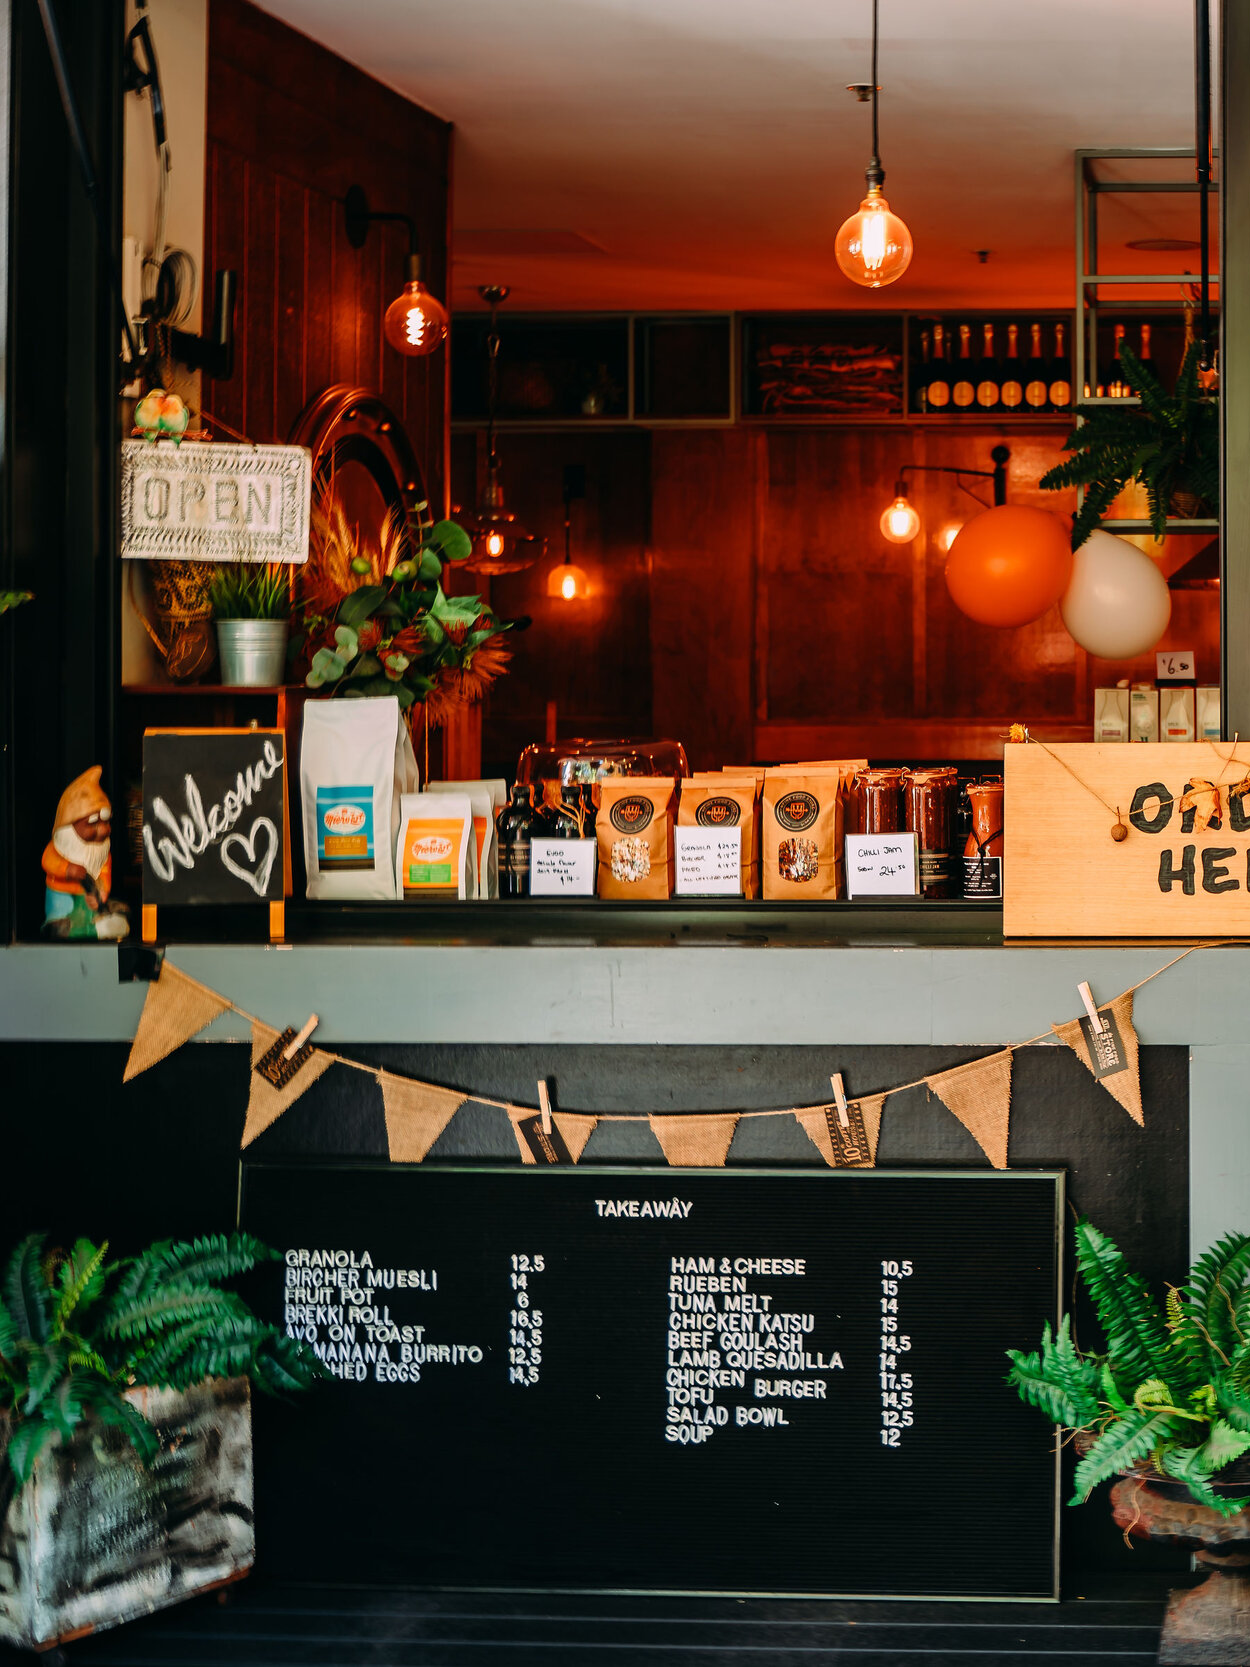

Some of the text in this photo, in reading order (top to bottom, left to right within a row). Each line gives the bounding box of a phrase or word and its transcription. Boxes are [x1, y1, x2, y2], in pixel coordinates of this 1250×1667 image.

[144, 478, 271, 525] OPEN
[143, 740, 284, 881] Welcome
[858, 849, 879, 857] CHILLI
[1101, 1032, 1116, 1067] STORE
[844, 1147, 862, 1162] 10
[595, 1199, 693, 1218] TAKEAWAY
[285, 1249, 373, 1268] GRANOLA
[671, 1257, 715, 1275] HAM
[719, 1257, 732, 1274] &
[734, 1258, 806, 1276] CHEESE
[285, 1268, 528, 1291] BIRCHER MUESLI 14
[669, 1275, 898, 1296] RUEBEN 15
[285, 1287, 529, 1308] FRUIT POT 6
[668, 1293, 899, 1314] TUNA MELT 14
[285, 1304, 344, 1325] BREKKI
[348, 1305, 394, 1326] ROLL
[669, 1312, 898, 1333] CHICKEN KATSU 15
[286, 1324, 318, 1343] AVO
[328, 1324, 356, 1344] ON
[365, 1325, 426, 1343] TOAST
[668, 1331, 713, 1350] BEEF
[720, 1332, 803, 1352] GOULASH
[313, 1342, 390, 1363] MANANA
[401, 1343, 483, 1365] BURRITO
[668, 1350, 897, 1371] LAMB QUESADILLA 14
[375, 1362, 420, 1382] EGGS
[666, 1369, 745, 1388] CHICKEN
[754, 1379, 827, 1399] BURGER
[666, 1387, 714, 1407] TOFU
[666, 1406, 729, 1426] SALAD
[736, 1406, 789, 1427] BOWL
[665, 1425, 901, 1447] SOUP 12
